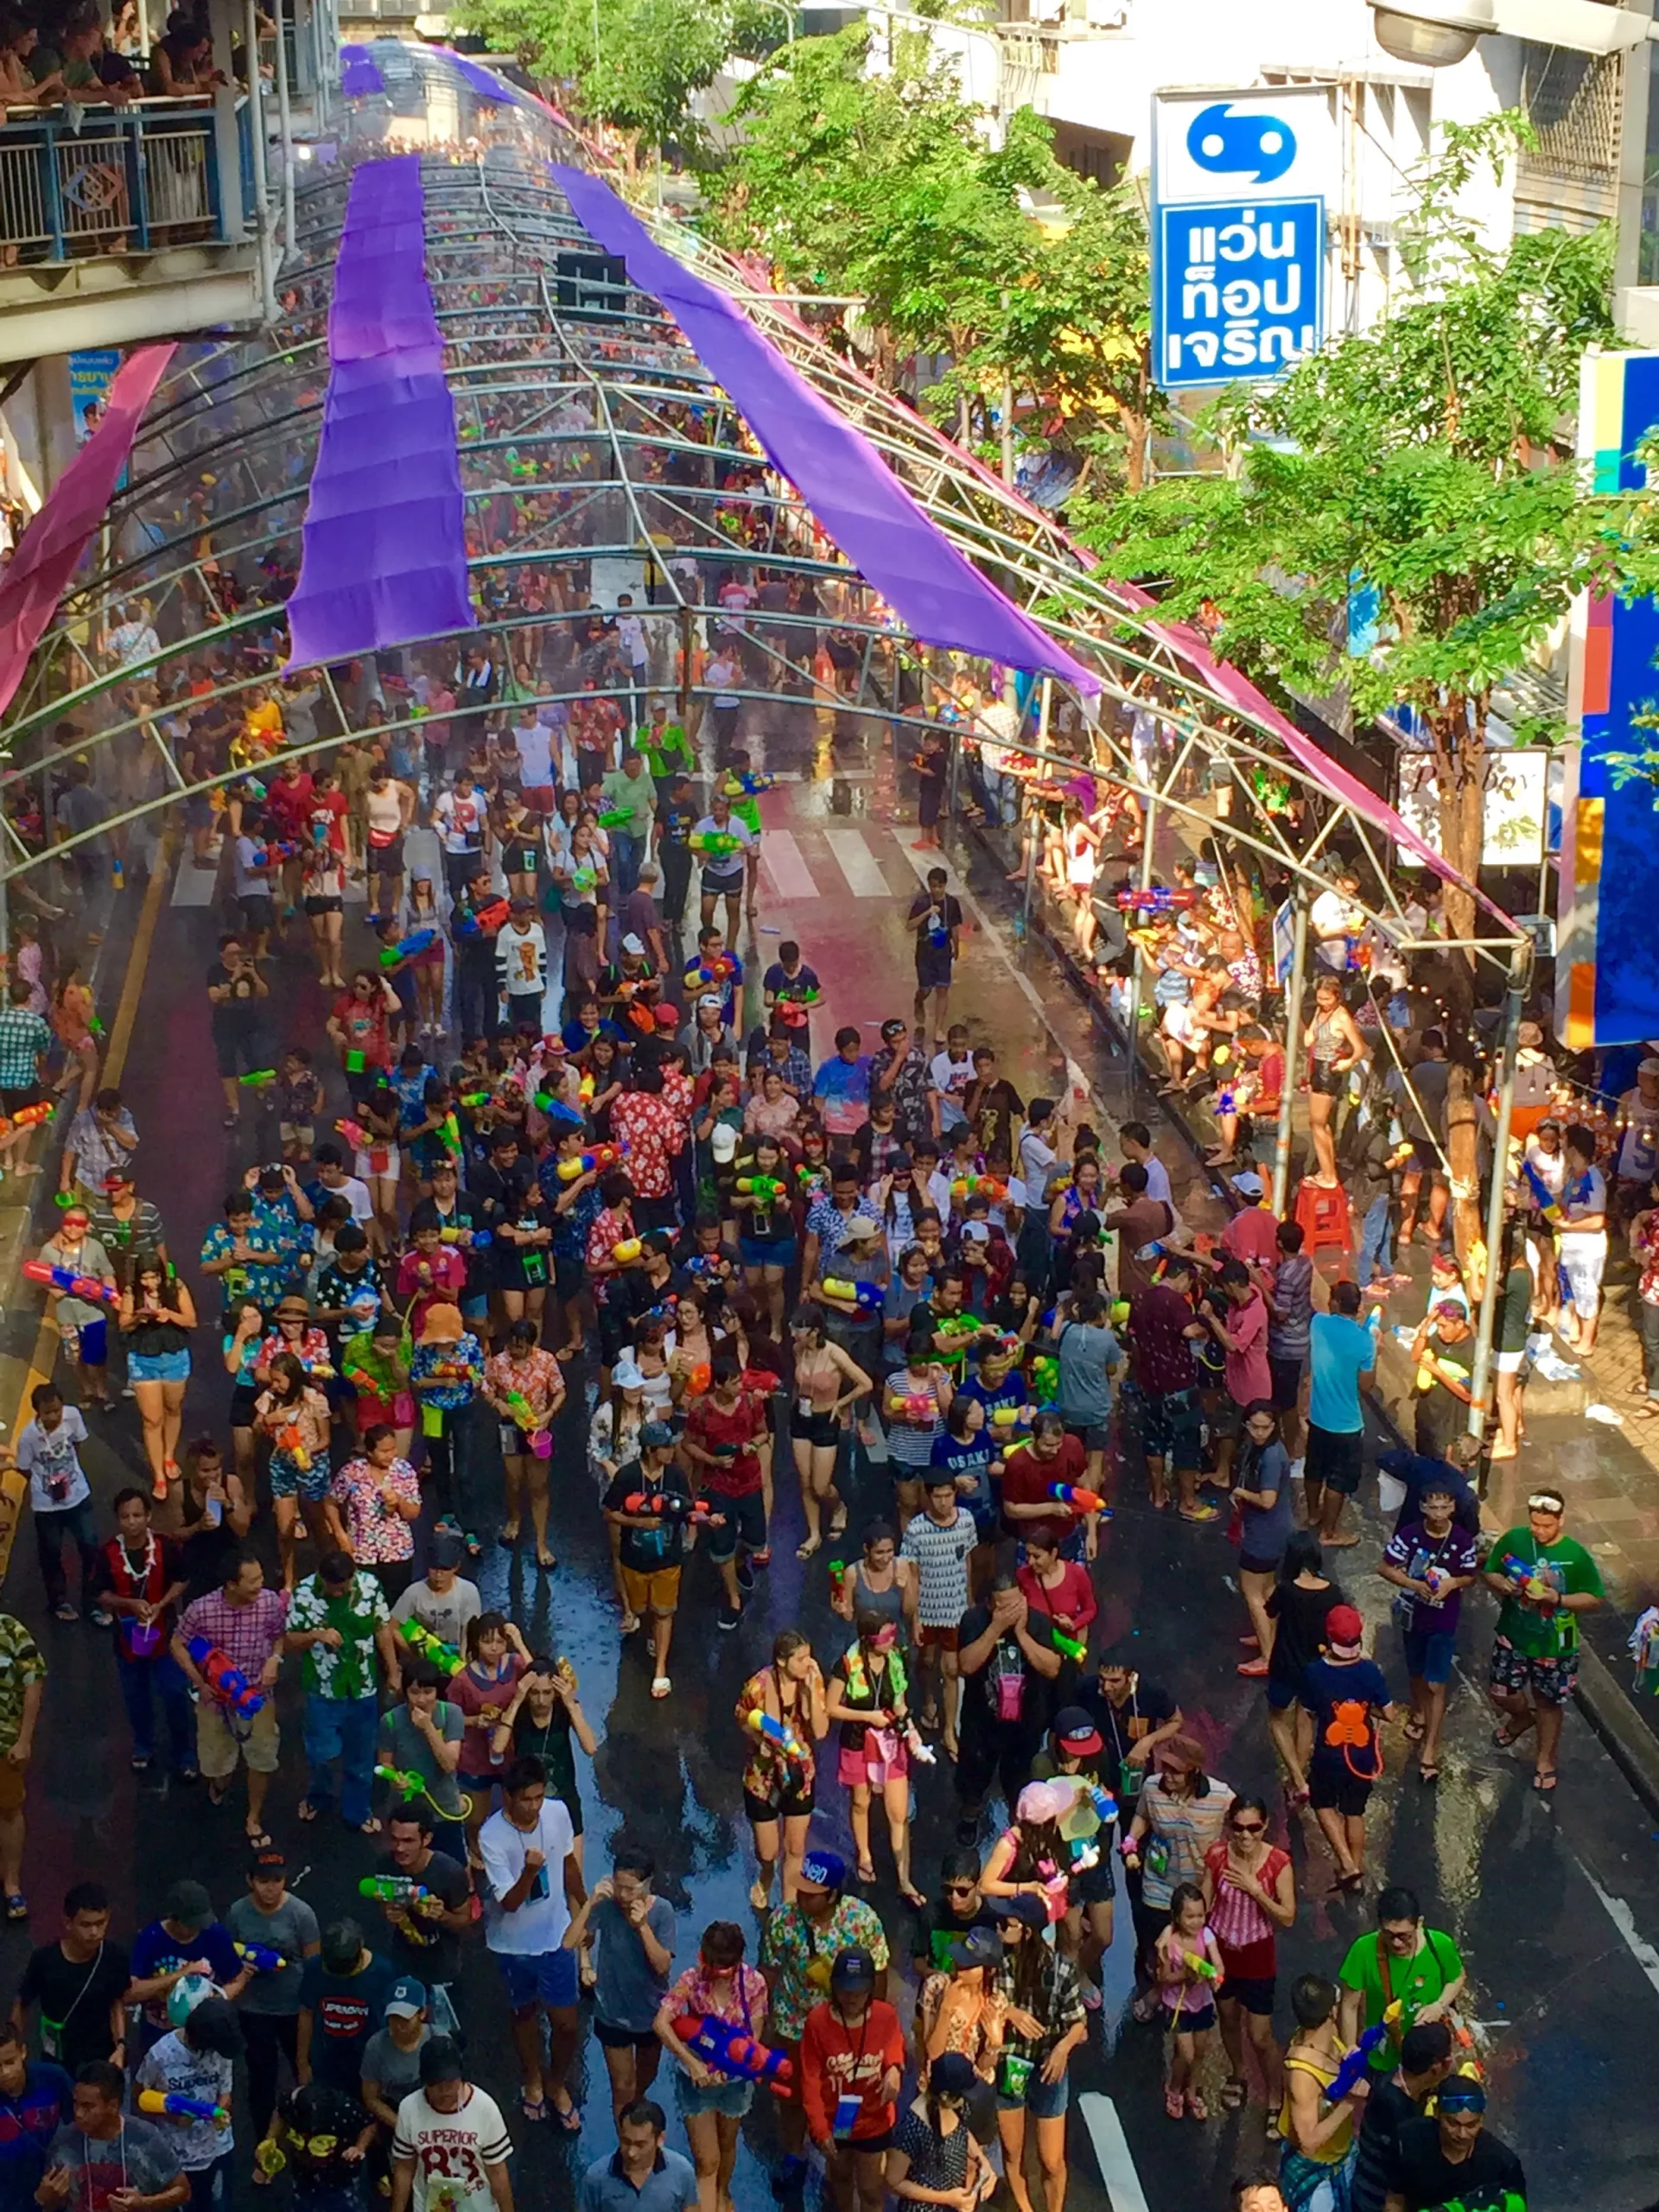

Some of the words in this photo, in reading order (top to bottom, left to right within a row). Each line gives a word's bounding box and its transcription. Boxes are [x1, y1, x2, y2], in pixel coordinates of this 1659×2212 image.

[1189, 209, 1295, 263] แว่น
[1182, 264, 1300, 319] ท็อป
[1168, 318, 1314, 369] เจริญ
[417, 2129, 479, 2145] SUPERIOR
